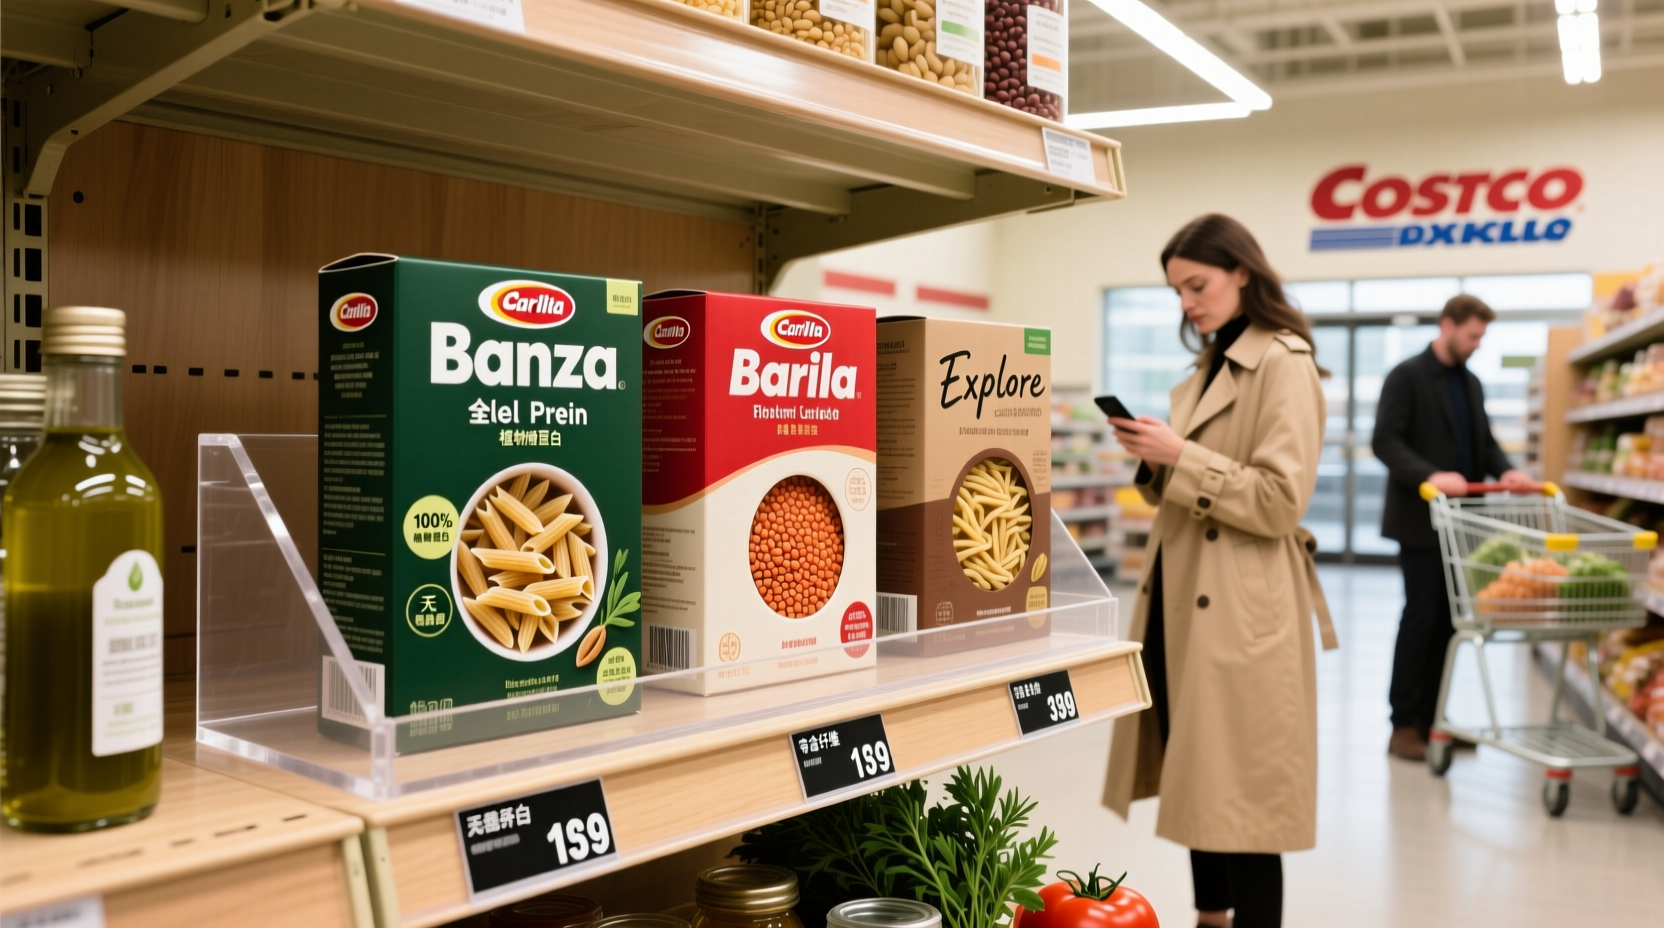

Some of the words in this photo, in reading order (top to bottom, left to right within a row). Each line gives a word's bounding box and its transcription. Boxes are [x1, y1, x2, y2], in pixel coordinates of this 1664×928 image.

[1311, 165, 1584, 221] COSTCO
[430, 321, 617, 390] Banza
[729, 348, 858, 399] Barila
[939, 350, 1046, 420] Explore
[530, 401, 588, 425] Prein
[413, 512, 453, 529] 100%
[1047, 690, 1076, 722] 399
